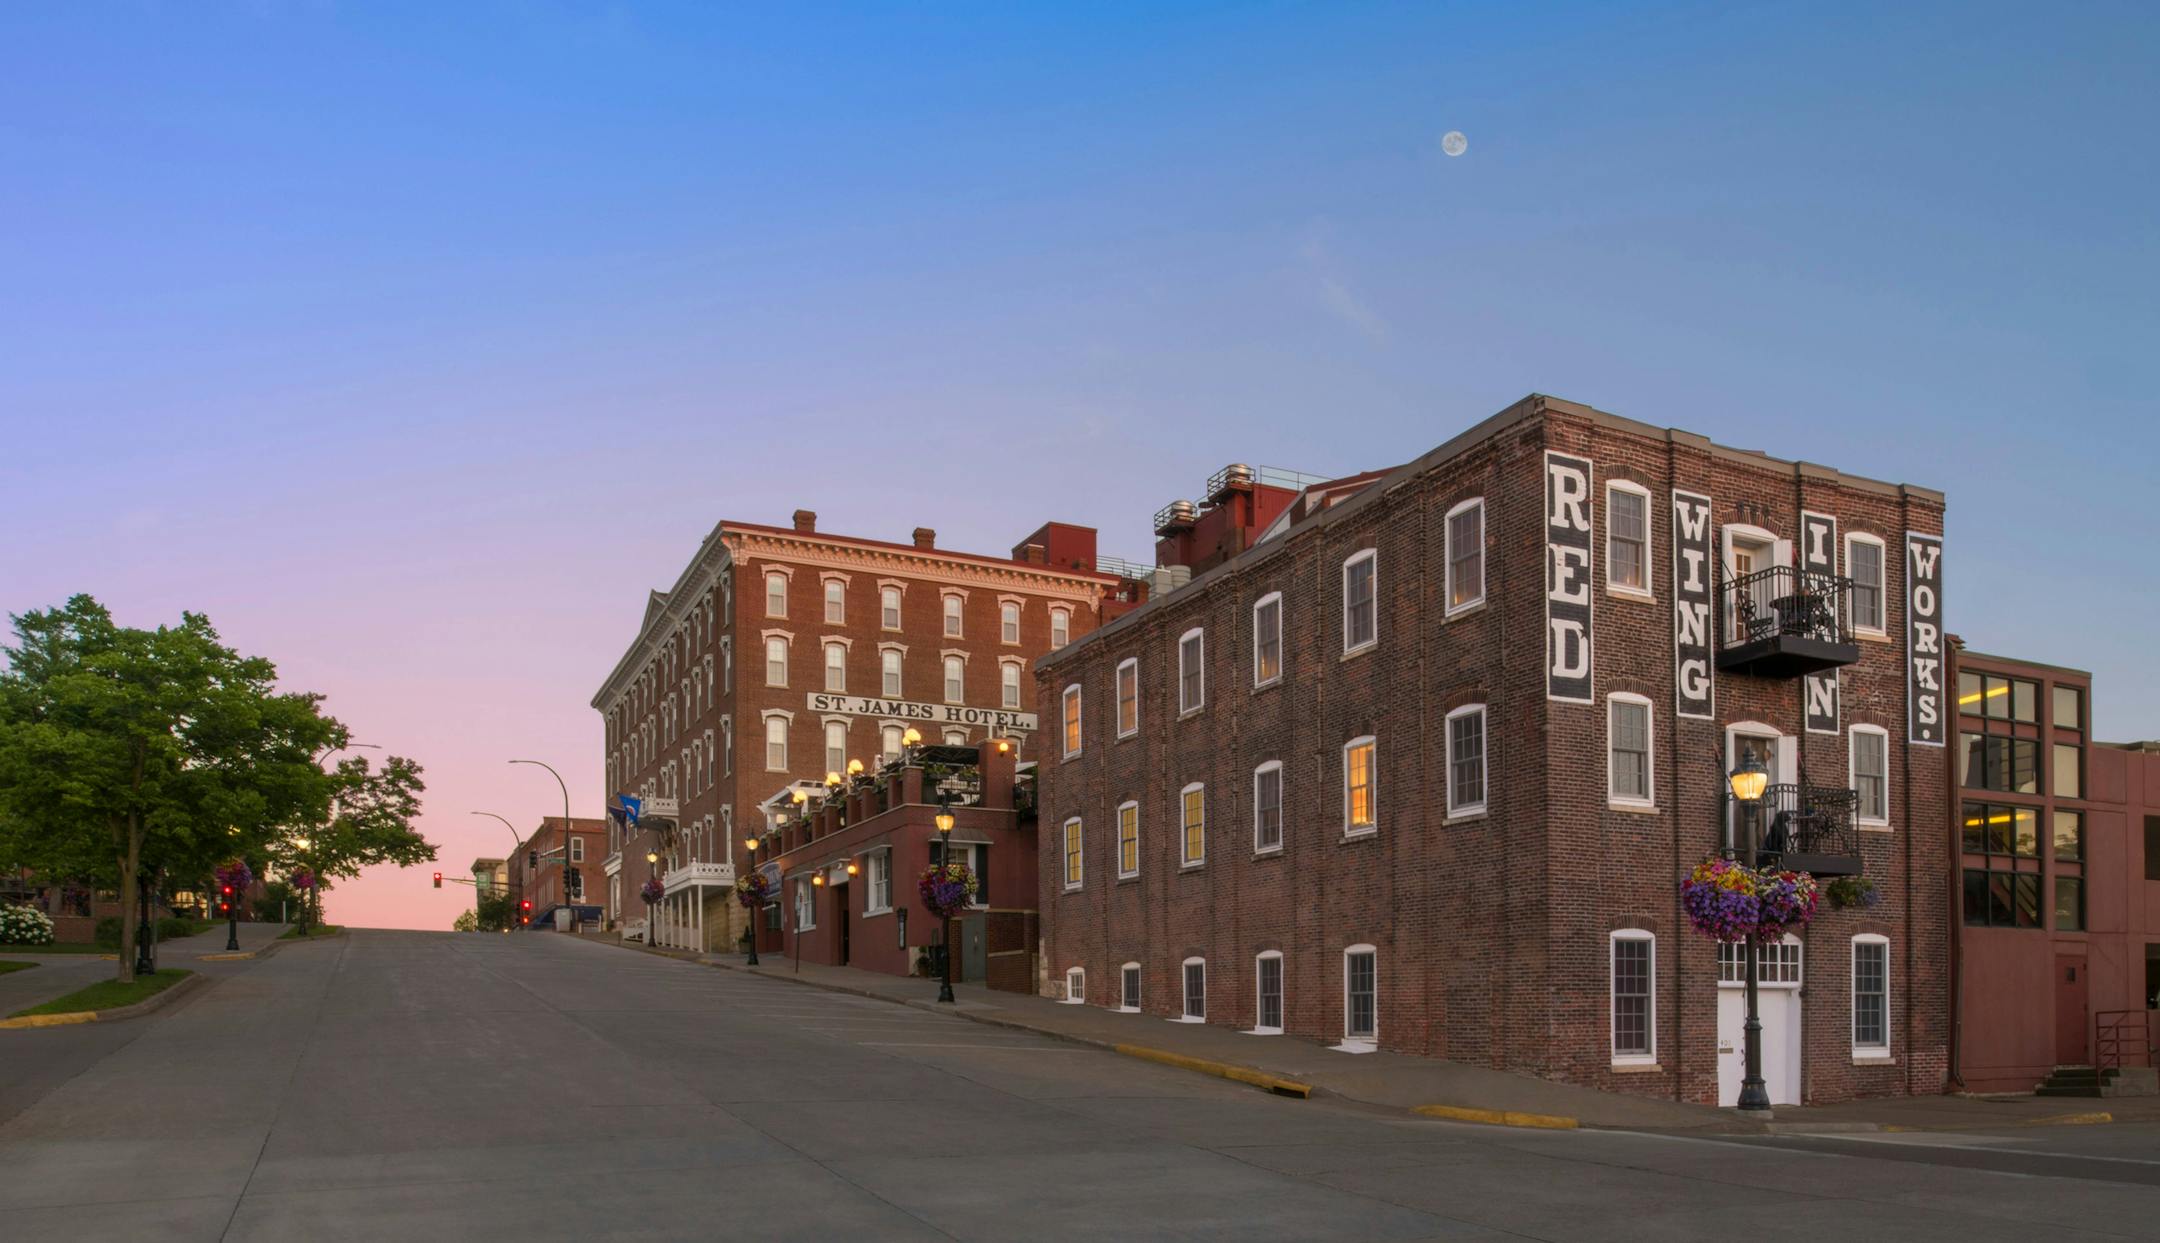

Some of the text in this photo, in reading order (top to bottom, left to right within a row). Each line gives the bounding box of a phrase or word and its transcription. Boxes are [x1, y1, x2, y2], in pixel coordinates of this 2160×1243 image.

[1549, 464, 1590, 678] RED
[1677, 501, 1710, 700] WING
[814, 695, 852, 711] ST.
[859, 699, 934, 718] JAMES
